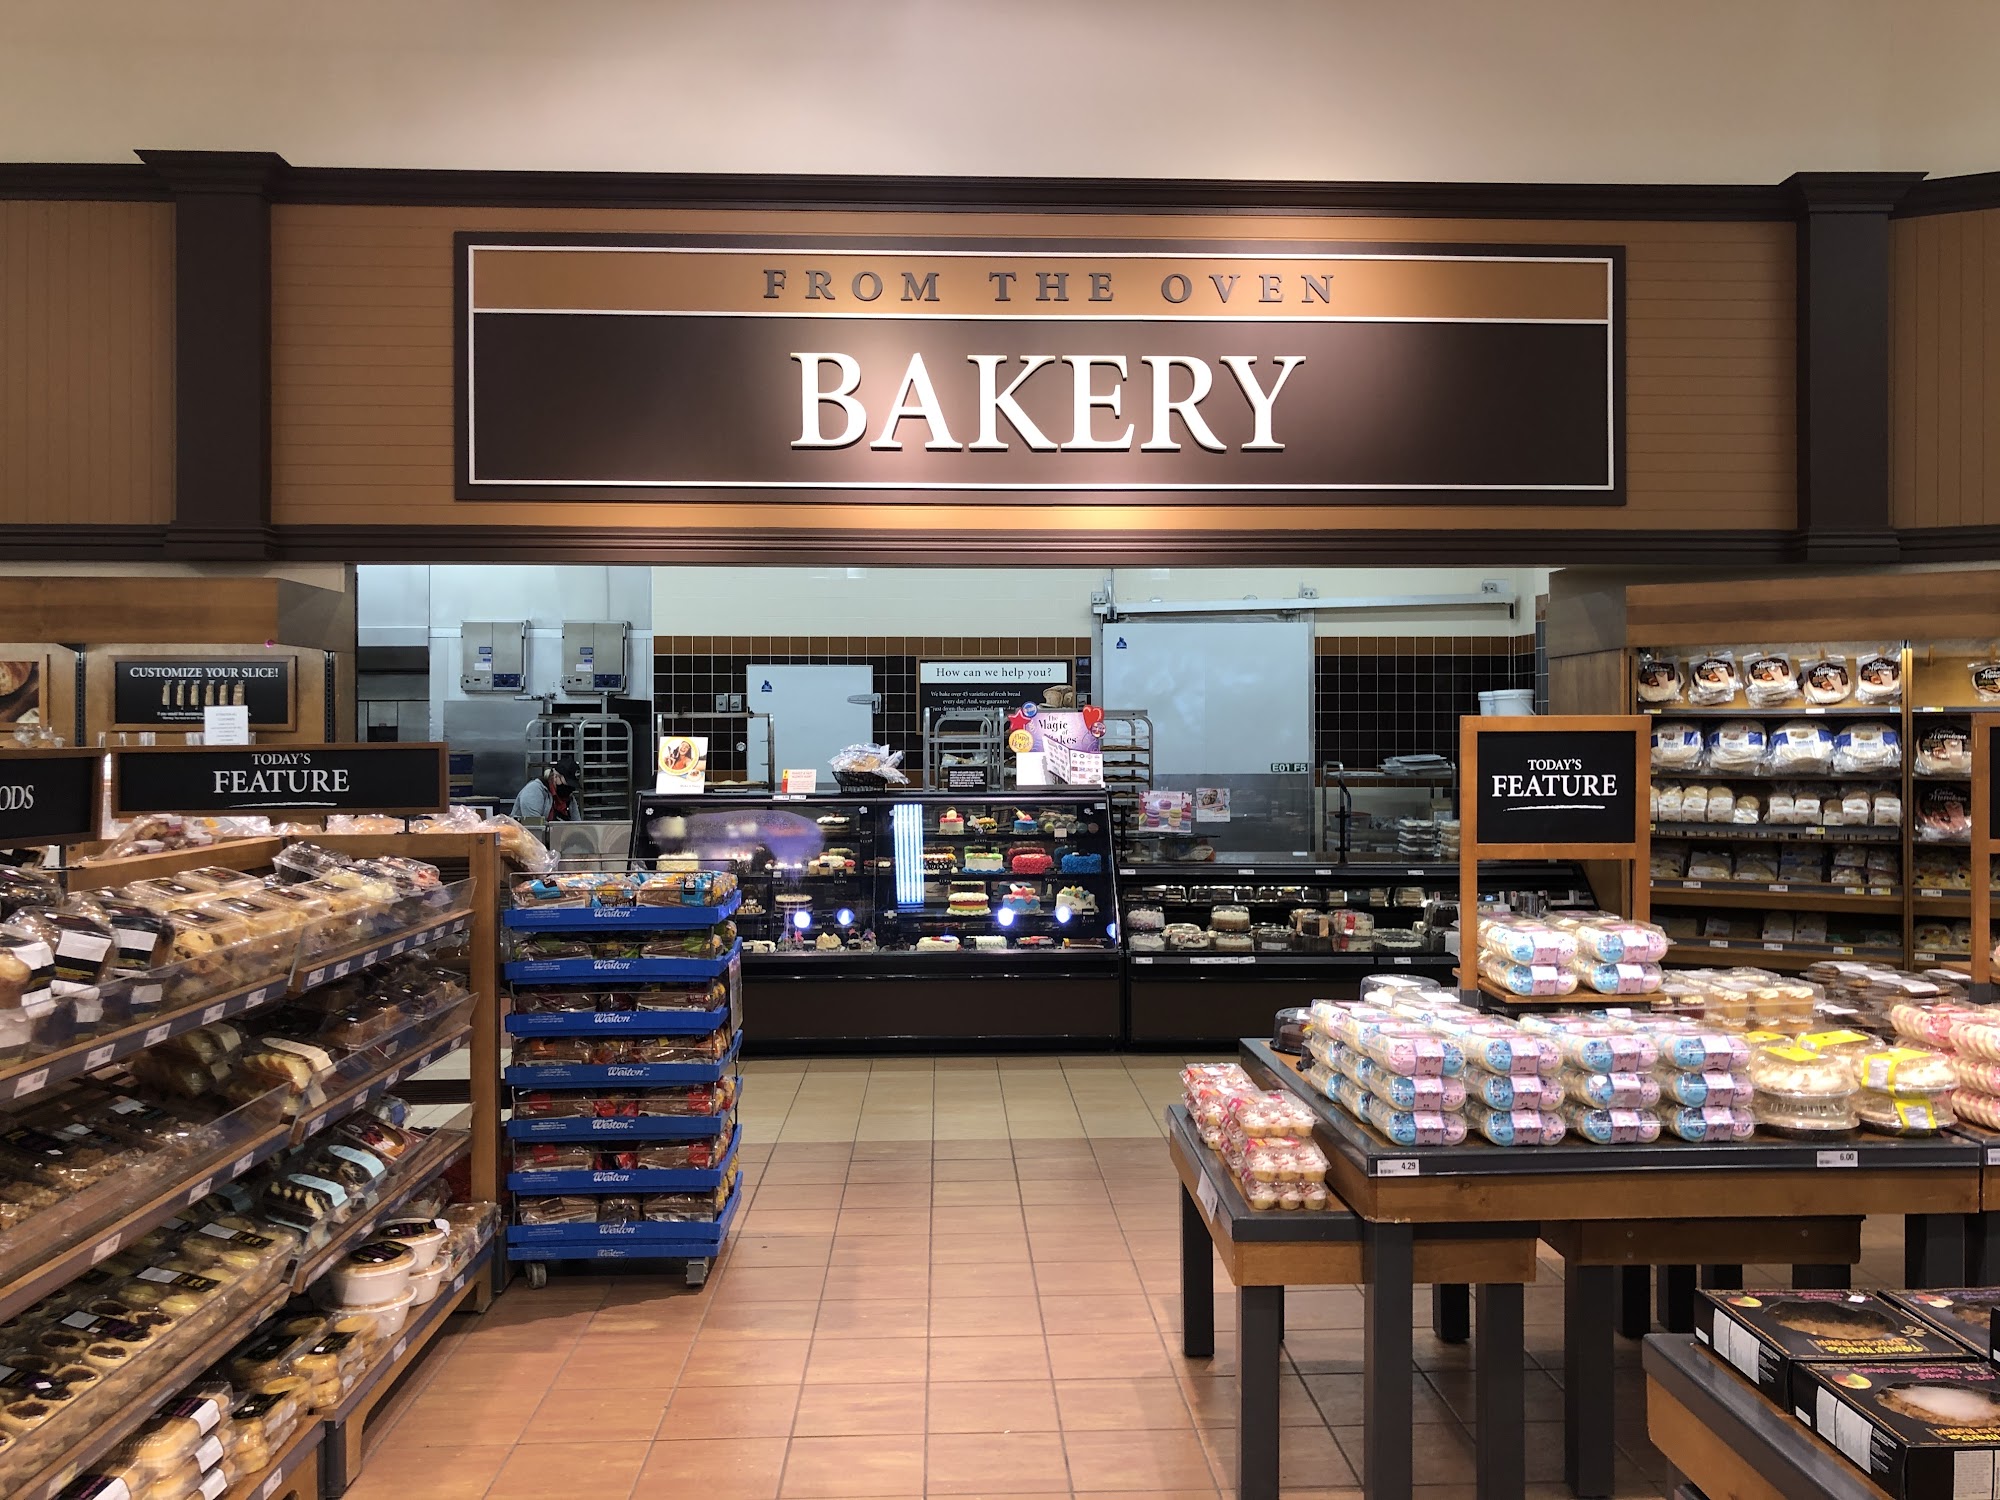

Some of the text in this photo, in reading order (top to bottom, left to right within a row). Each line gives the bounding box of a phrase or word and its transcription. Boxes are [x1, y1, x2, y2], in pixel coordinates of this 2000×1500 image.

[762, 269, 1335, 303] FROM THE OVEN
[789, 351, 1307, 453] BAKERY
[130, 667, 279, 678] CUSTOMIZE YOUR SLICE!
[936, 667, 960, 677] How
[1001, 667, 1024, 679] help
[1027, 668, 1052, 679] you?
[1038, 719, 1068, 732] Magic
[252, 752, 311, 766] TODAY'S
[1527, 758, 1582, 771] TODAY'S
[1272, 763, 1307, 772] E01 F5
[213, 769, 350, 794] FEATURE
[1492, 774, 1617, 799] FEATURE
[593, 908, 631, 918] Weston
[593, 960, 631, 970] Weston
[593, 1013, 631, 1023] Weston
[607, 1066, 644, 1077] Weston
[591, 1119, 629, 1130] Weston
[1839, 1153, 1855, 1161] 6.00
[593, 1172, 630, 1182] Weston
[599, 1224, 635, 1234] Weston
